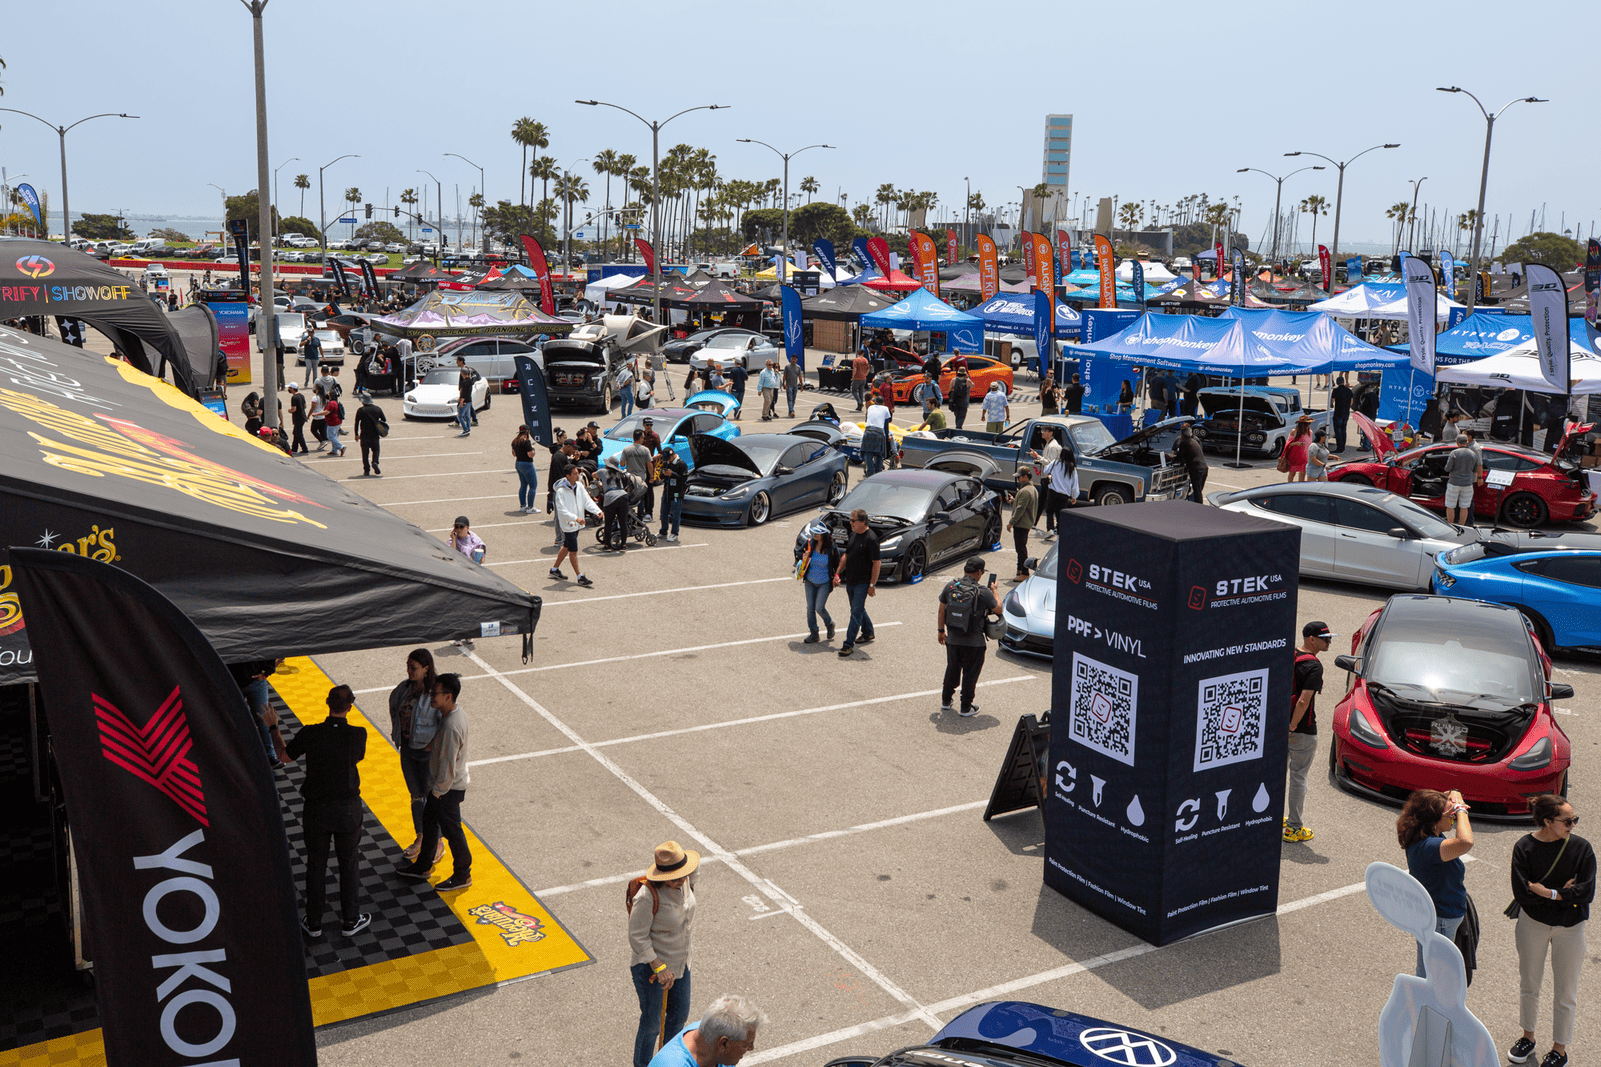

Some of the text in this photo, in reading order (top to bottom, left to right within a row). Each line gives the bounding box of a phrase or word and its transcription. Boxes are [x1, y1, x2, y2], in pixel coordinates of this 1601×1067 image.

[984, 260, 994, 279] LIFT
[0, 286, 39, 302] RIFY
[51, 285, 131, 301] SHOWOFF
[1142, 337, 1217, 350] shopmonkey
[1123, 354, 1156, 364] Management
[1157, 358, 1181, 367] Software
[1089, 564, 1151, 592] STEK USA
[1216, 574, 1282, 596] STEK USA
[1085, 581, 1158, 611] PROTECTIVE AUTOMOTIVE FILMS
[1211, 592, 1287, 608] PROTECTIVE AUTOMOTIVE FILMS
[1067, 614, 1092, 637] PPF
[1105, 628, 1146, 658] VINYL
[1183, 638, 1287, 664] INNOVATING NEW STANDARDS
[1201, 823, 1240, 837] Puncture Resistant
[1245, 815, 1273, 826] Hydrophobic
[1120, 826, 1149, 843] Hydrophobic
[1057, 863, 1076, 879] Protection
[1077, 874, 1085, 884] Film
[1088, 881, 1104, 894] Fashion
[1104, 889, 1114, 899] Film
[1117, 896, 1136, 910] Window
[1136, 905, 1147, 916] Tint
[1167, 909, 1177, 918] Paint
[1177, 903, 1198, 914] Protection
[1210, 894, 1227, 904] Fashion
[1240, 887, 1259, 895] Window
[133, 828, 241, 1067] YOKO
